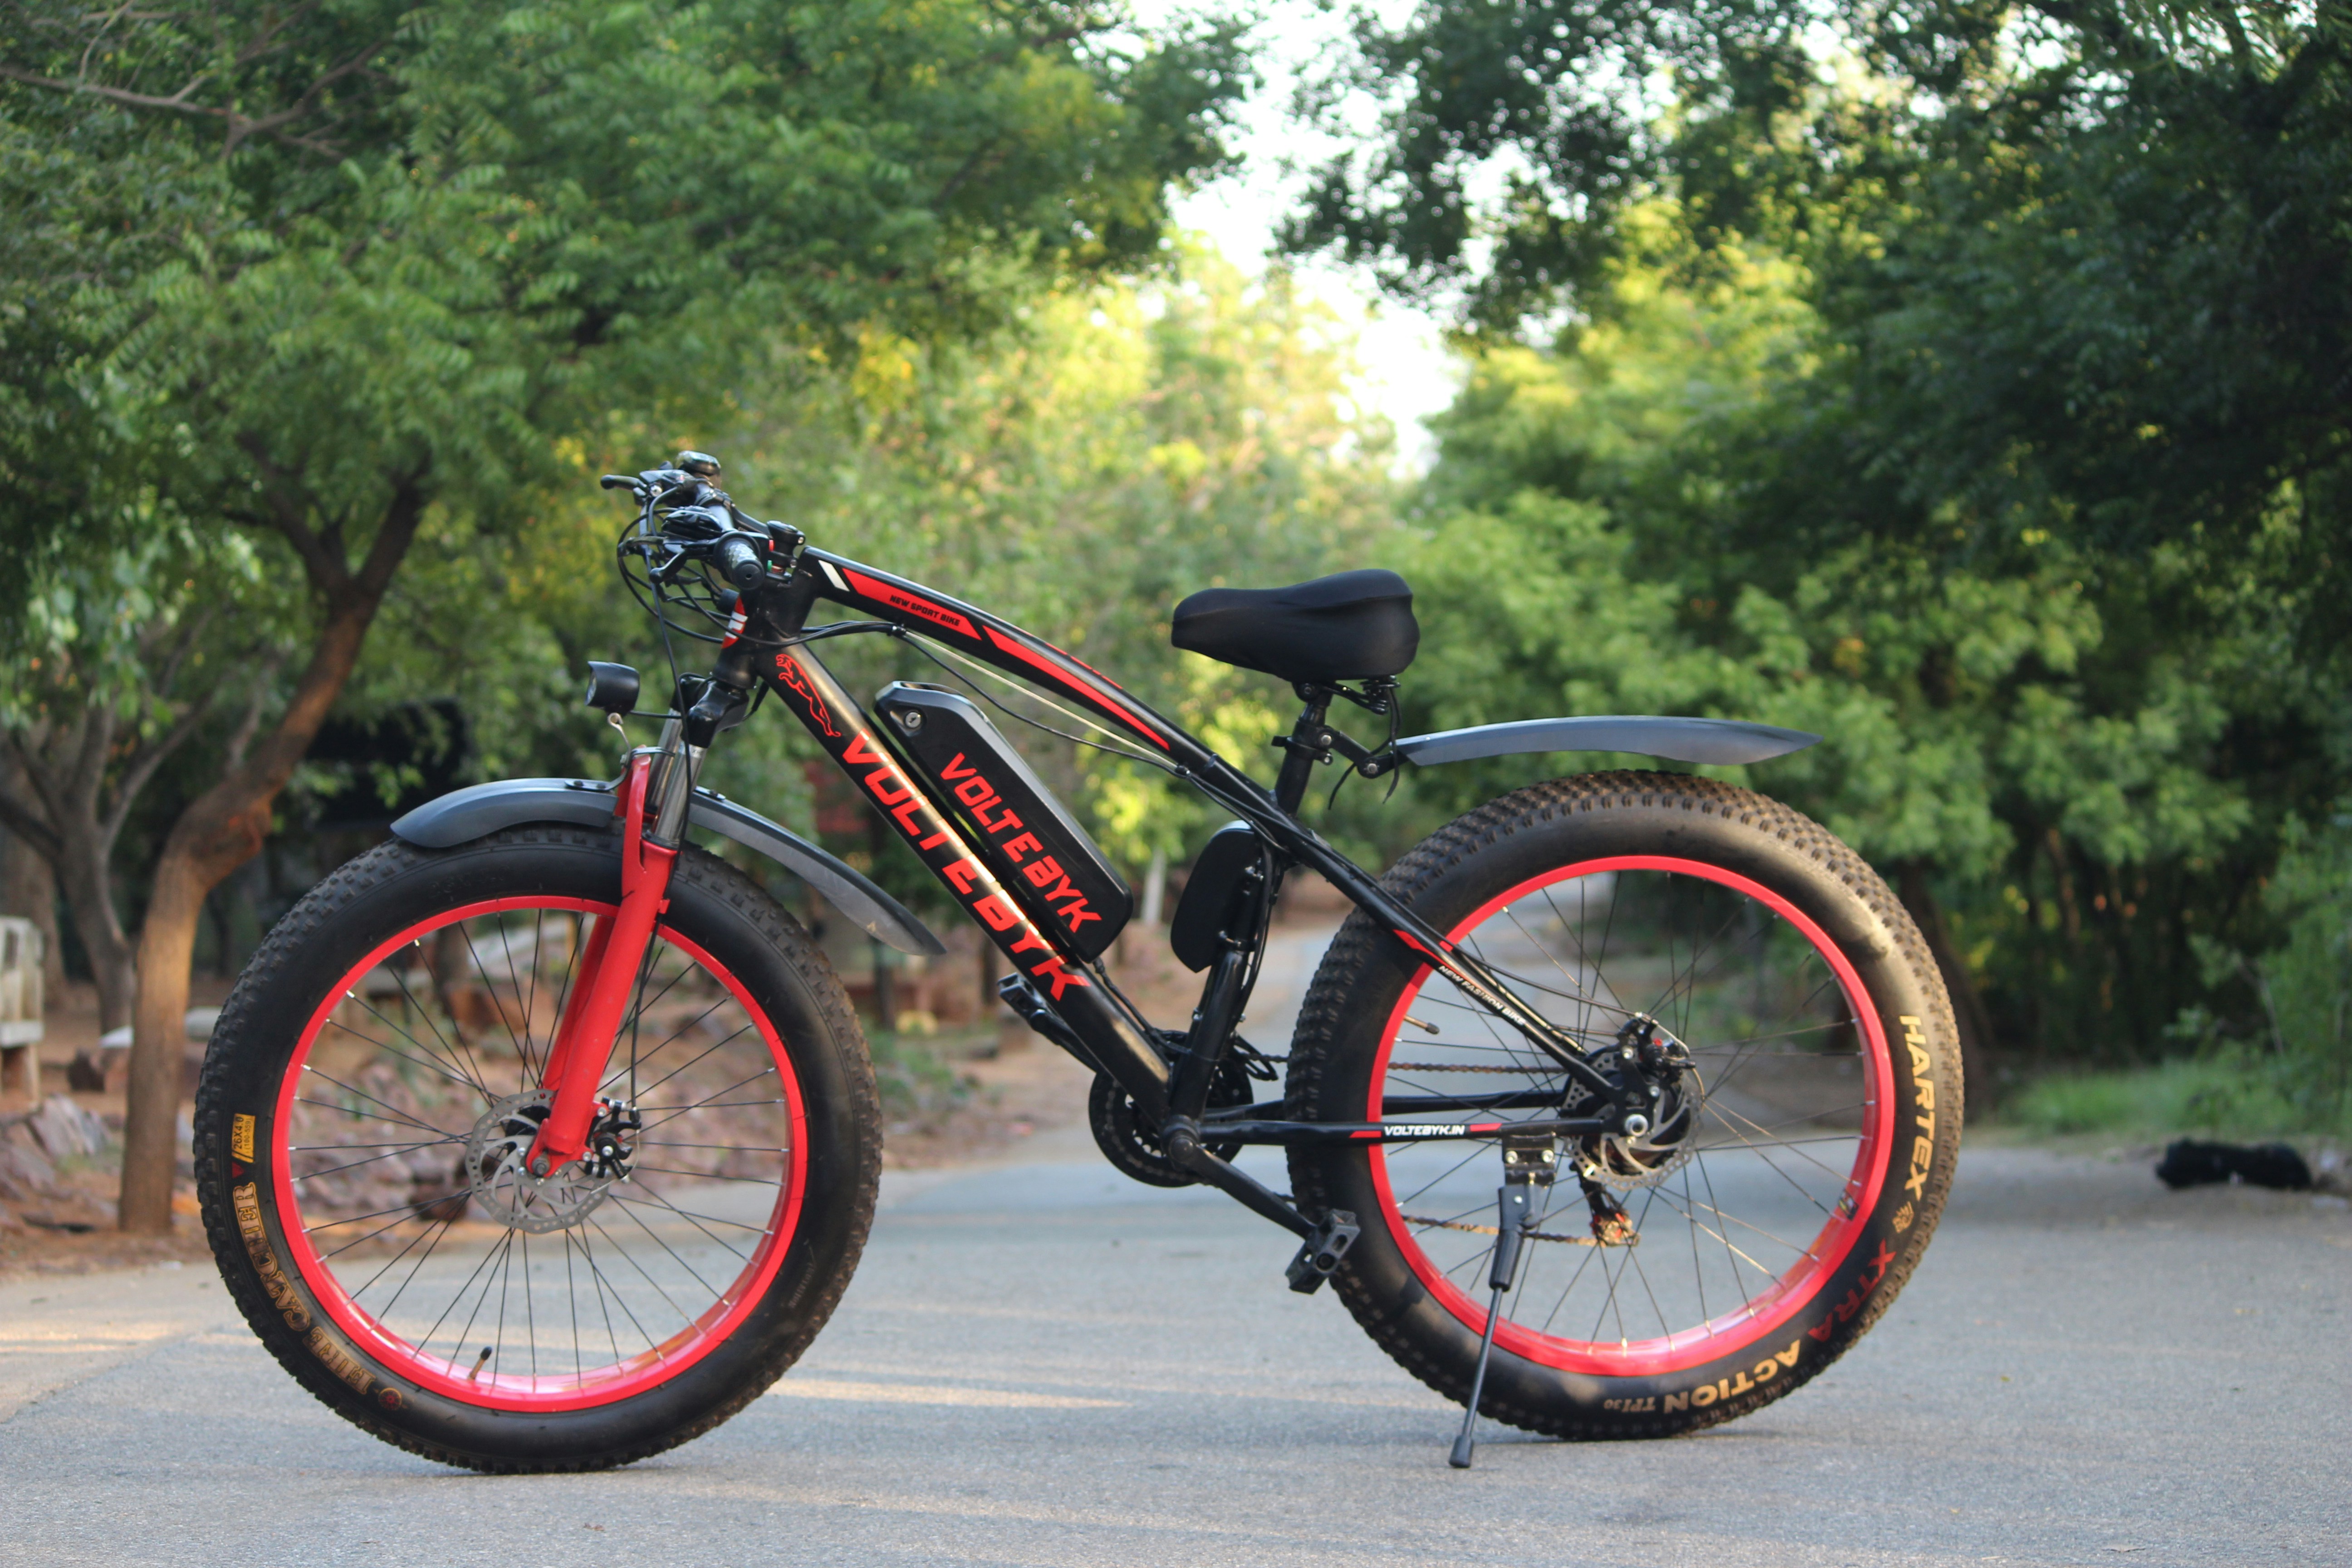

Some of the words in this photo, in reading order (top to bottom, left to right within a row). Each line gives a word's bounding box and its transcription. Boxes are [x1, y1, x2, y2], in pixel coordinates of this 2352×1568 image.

[890, 595, 910, 607] NEW
[911, 603, 940, 617] SPORT
[940, 613, 960, 626] BIKE
[1439, 965, 1464, 982] NEW
[1461, 981, 1504, 1009] FASHION
[1502, 1008, 1526, 1025] BIKE
[232, 1116, 244, 1149] 26X4.0
[1384, 1125, 1465, 1136] VOLTEBYK.IN
[1899, 1015, 1936, 1201] HARTEX
[232, 1181, 310, 1332] CATCHER
[1808, 1239, 1896, 1342] XTRA
[303, 1327, 376, 1396] FIRE
[1664, 1339, 1801, 1414] ACTION
